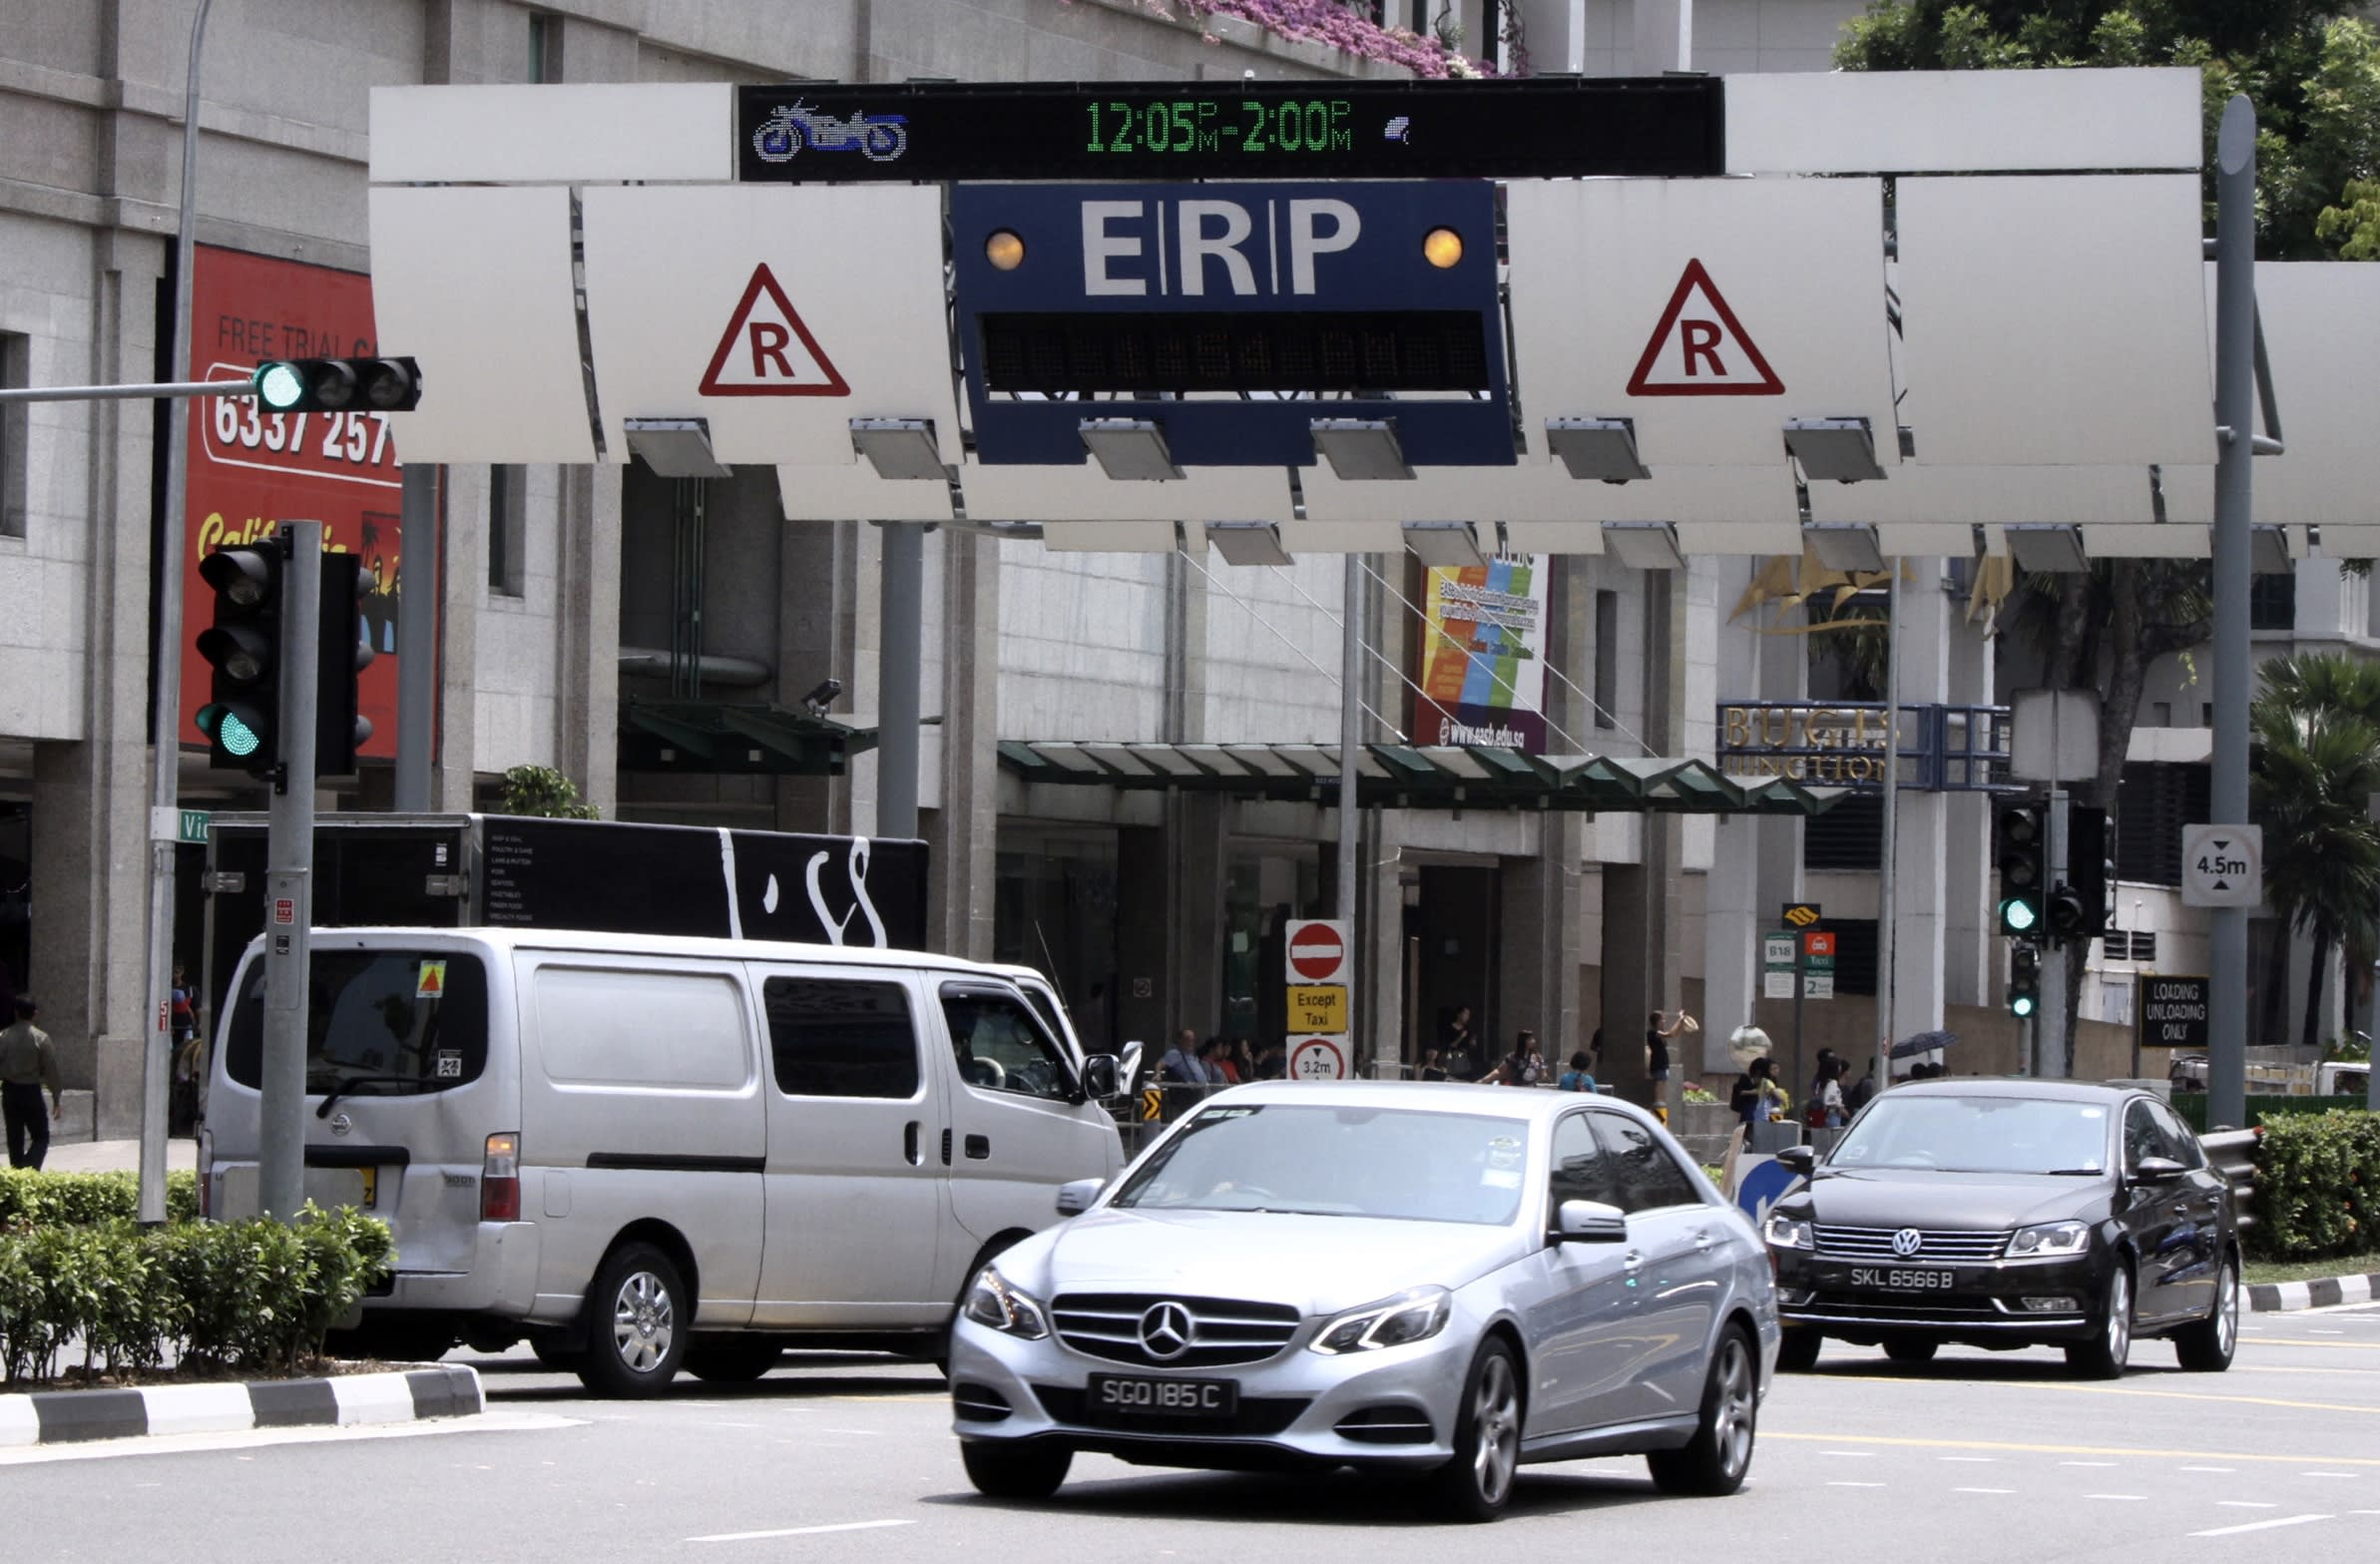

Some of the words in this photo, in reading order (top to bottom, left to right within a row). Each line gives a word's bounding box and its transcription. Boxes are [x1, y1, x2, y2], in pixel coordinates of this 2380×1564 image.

[219, 315, 274, 358] FREE
[749, 322, 795, 377] R
[1680, 319, 1727, 376] R
[216, 395, 307, 452] 6337
[322, 411, 402, 466] 257
[199, 512, 347, 562] Califi
[2197, 856, 2245, 875] 4.5m
[1297, 992, 1336, 1008] Except
[2153, 983, 2199, 1000] LOADING
[1305, 1012, 1328, 1026] Taxi
[2146, 1004, 2205, 1021] UNLOADING
[2161, 1023, 2188, 1040] ONLY
[1303, 1061, 1331, 1074] 3.2m
